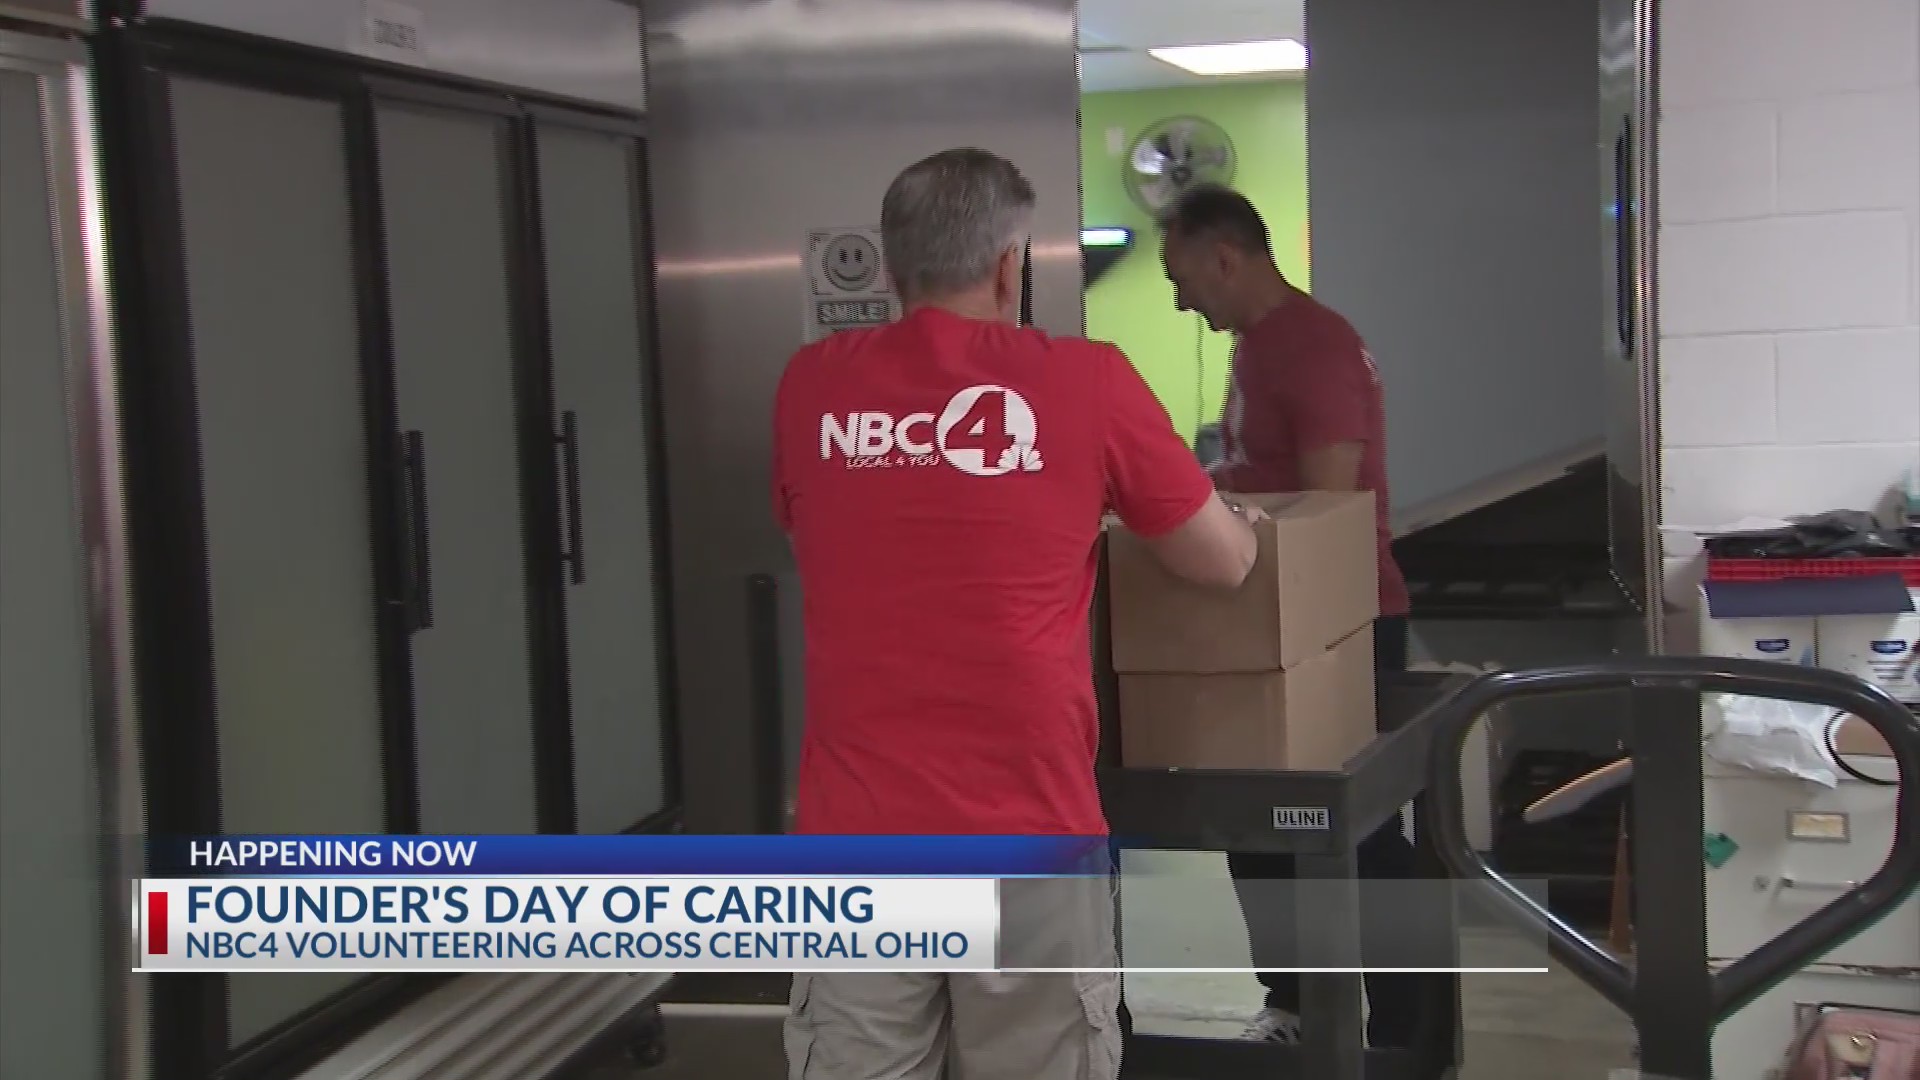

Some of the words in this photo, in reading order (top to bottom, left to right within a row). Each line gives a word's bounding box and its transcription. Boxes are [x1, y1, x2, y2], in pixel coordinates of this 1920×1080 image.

[820, 302, 887, 322] SMILE!
[846, 455, 892, 470] LOCAL
[895, 456, 904, 467] 4
[907, 454, 940, 467] YOU
[1277, 810, 1325, 826] ULINE
